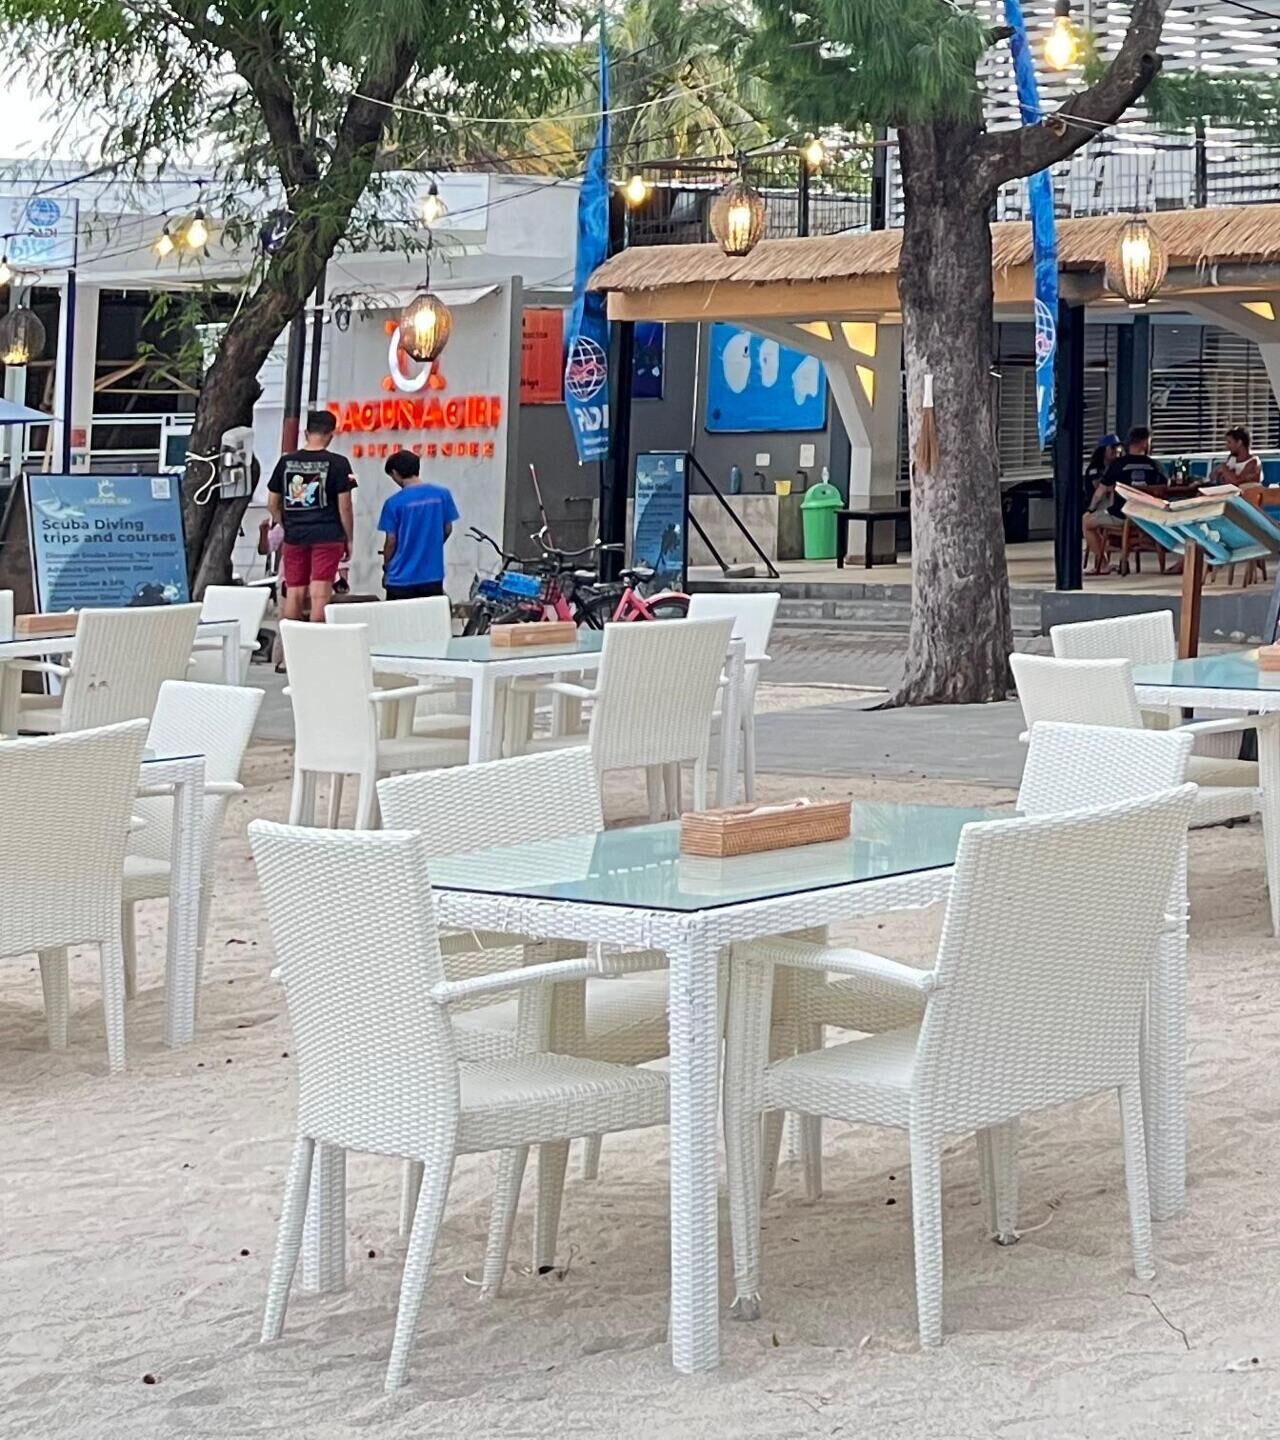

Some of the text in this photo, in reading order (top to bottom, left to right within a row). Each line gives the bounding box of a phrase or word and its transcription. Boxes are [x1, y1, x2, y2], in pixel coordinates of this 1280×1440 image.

[574, 404, 609, 433] PADI
[42, 518, 144, 531] Scuba Diving
[43, 532, 177, 545] trips and courses
